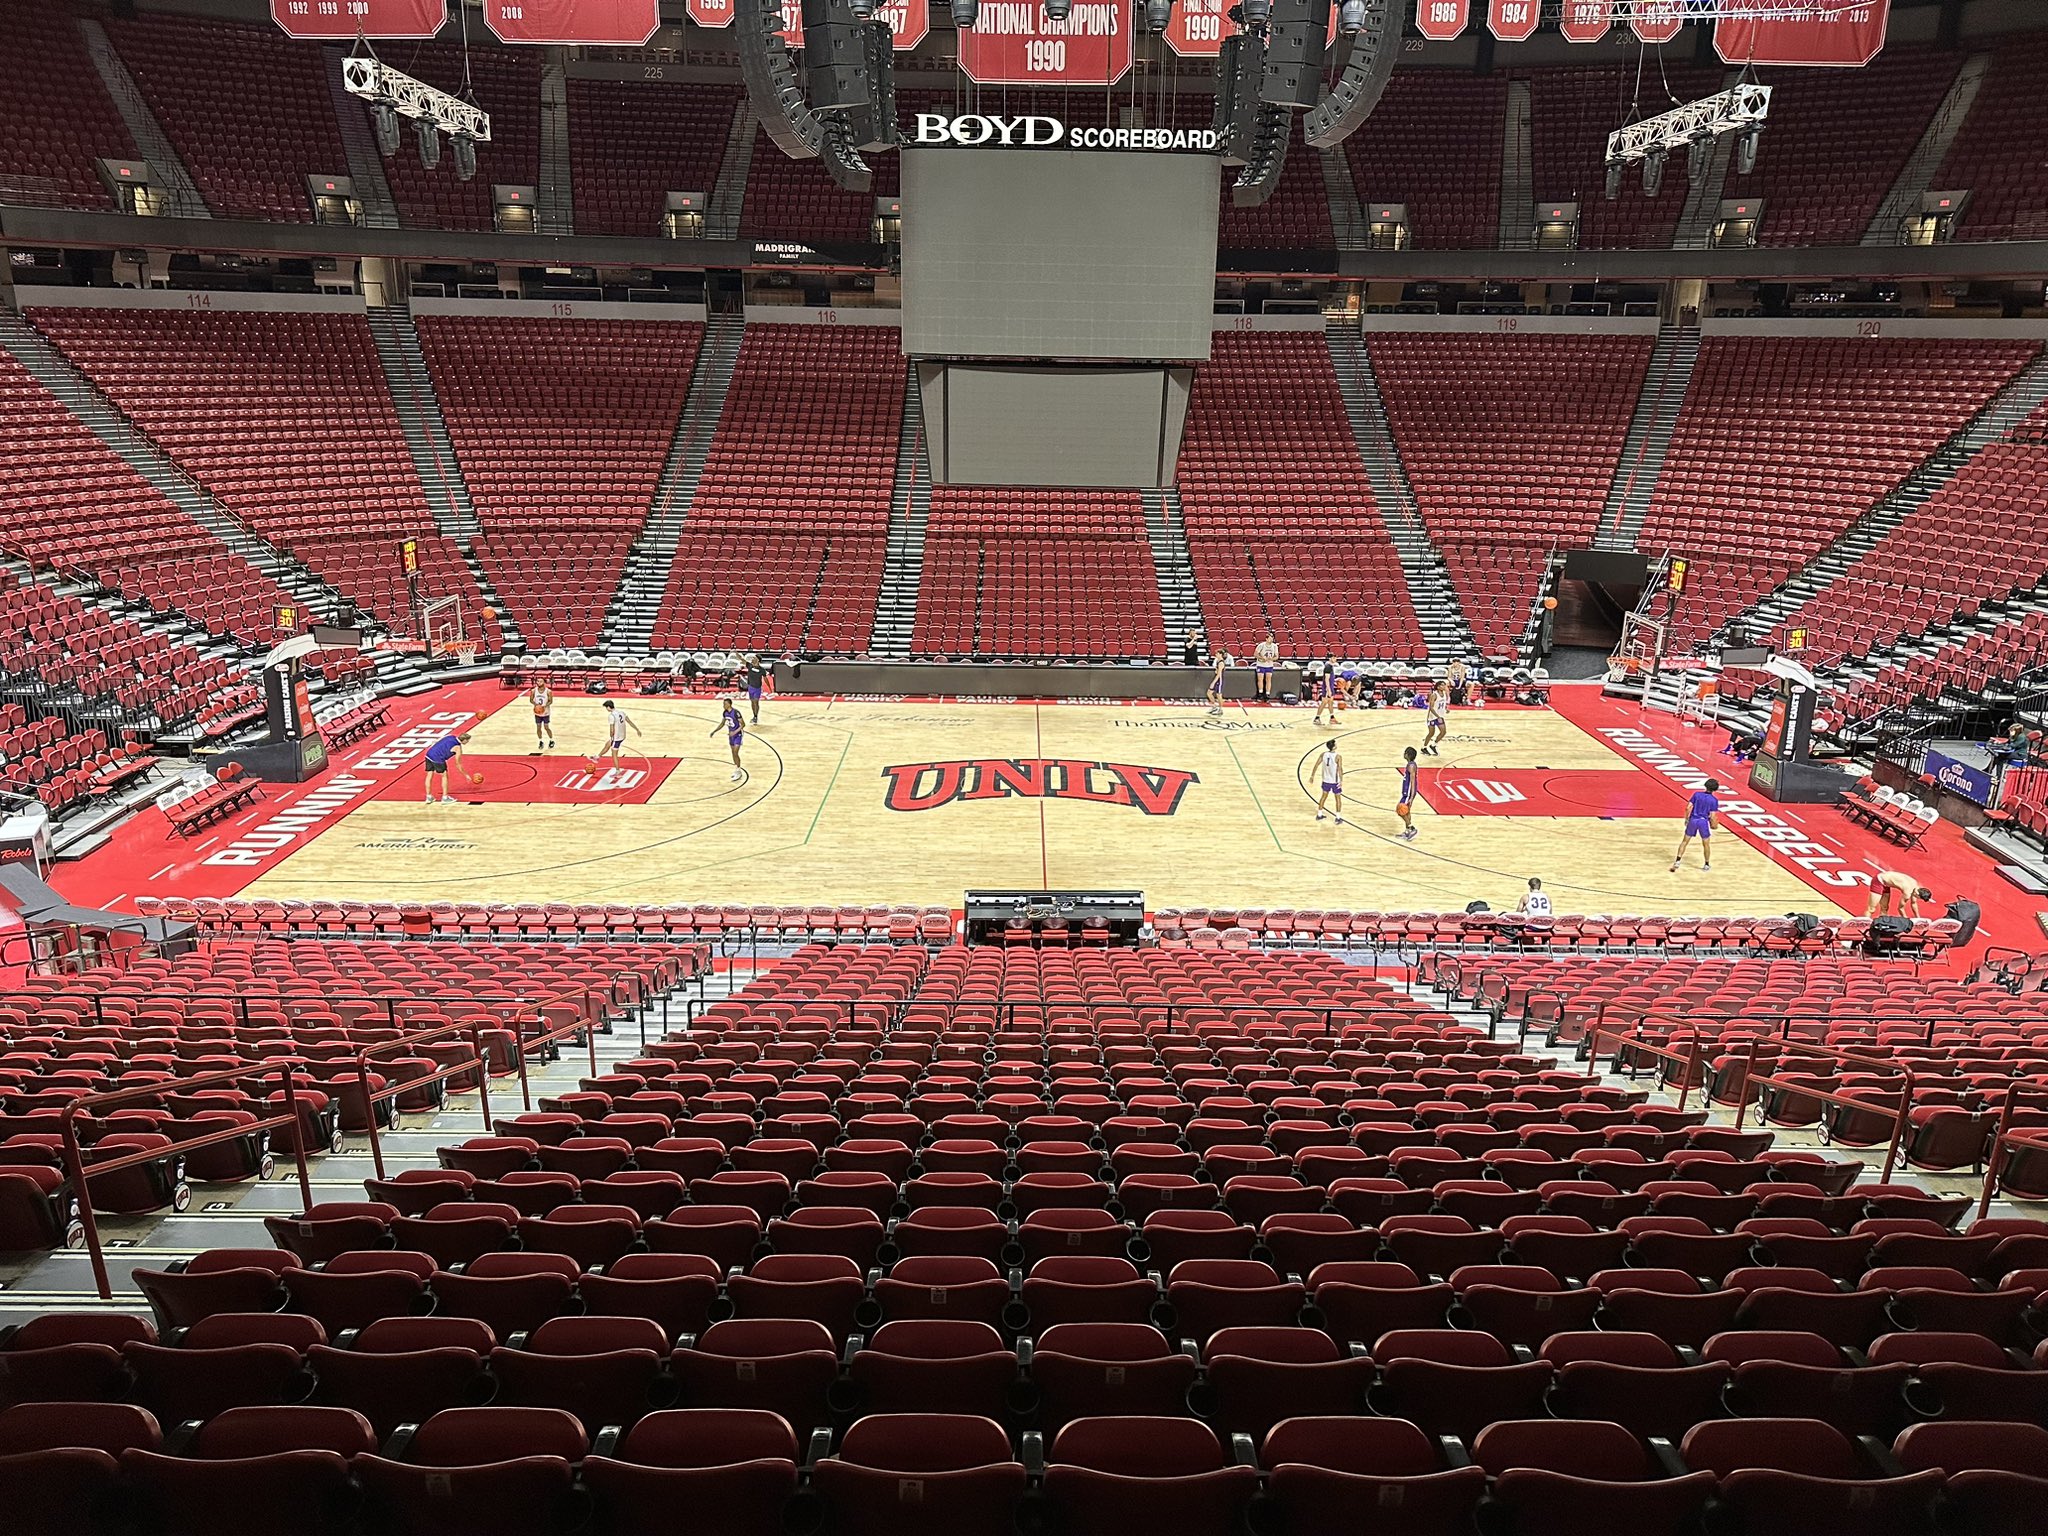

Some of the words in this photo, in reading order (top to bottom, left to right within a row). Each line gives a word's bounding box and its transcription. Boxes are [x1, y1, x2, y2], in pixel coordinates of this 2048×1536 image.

[318, 2, 338, 15] 1999
[501, 7, 523, 20] 2008
[1430, 2, 1458, 23] 1986
[1501, 3, 1528, 24] 1984
[972, 3, 1036, 35] NATIONAL
[1848, 9, 1870, 23] 2013
[1184, 15, 1220, 41] 1990
[1405, 40, 1424, 51] 229
[1615, 33, 1635, 45] 230
[1024, 40, 1066, 72] 1990
[644, 67, 664, 80] 225
[914, 113, 1064, 145] BOYD
[1070, 127, 1217, 149] SCOREBOARD
[187, 294, 211, 308] 114
[551, 304, 573, 316] 115
[817, 310, 837, 323] 116
[1234, 318, 1253, 330] 118
[1497, 318, 1517, 331] 119
[1856, 321, 1881, 336] 120
[279, 617, 293, 627] 30
[1789, 638, 1802, 649] 30
[352, 711, 478, 770] REBELS
[1938, 766, 1974, 792] Corona
[881, 758, 1202, 816] UNLV
[1716, 800, 1874, 887] REBELS
[0, 847, 33, 859] Rebels
[1530, 897, 1549, 910] 32
